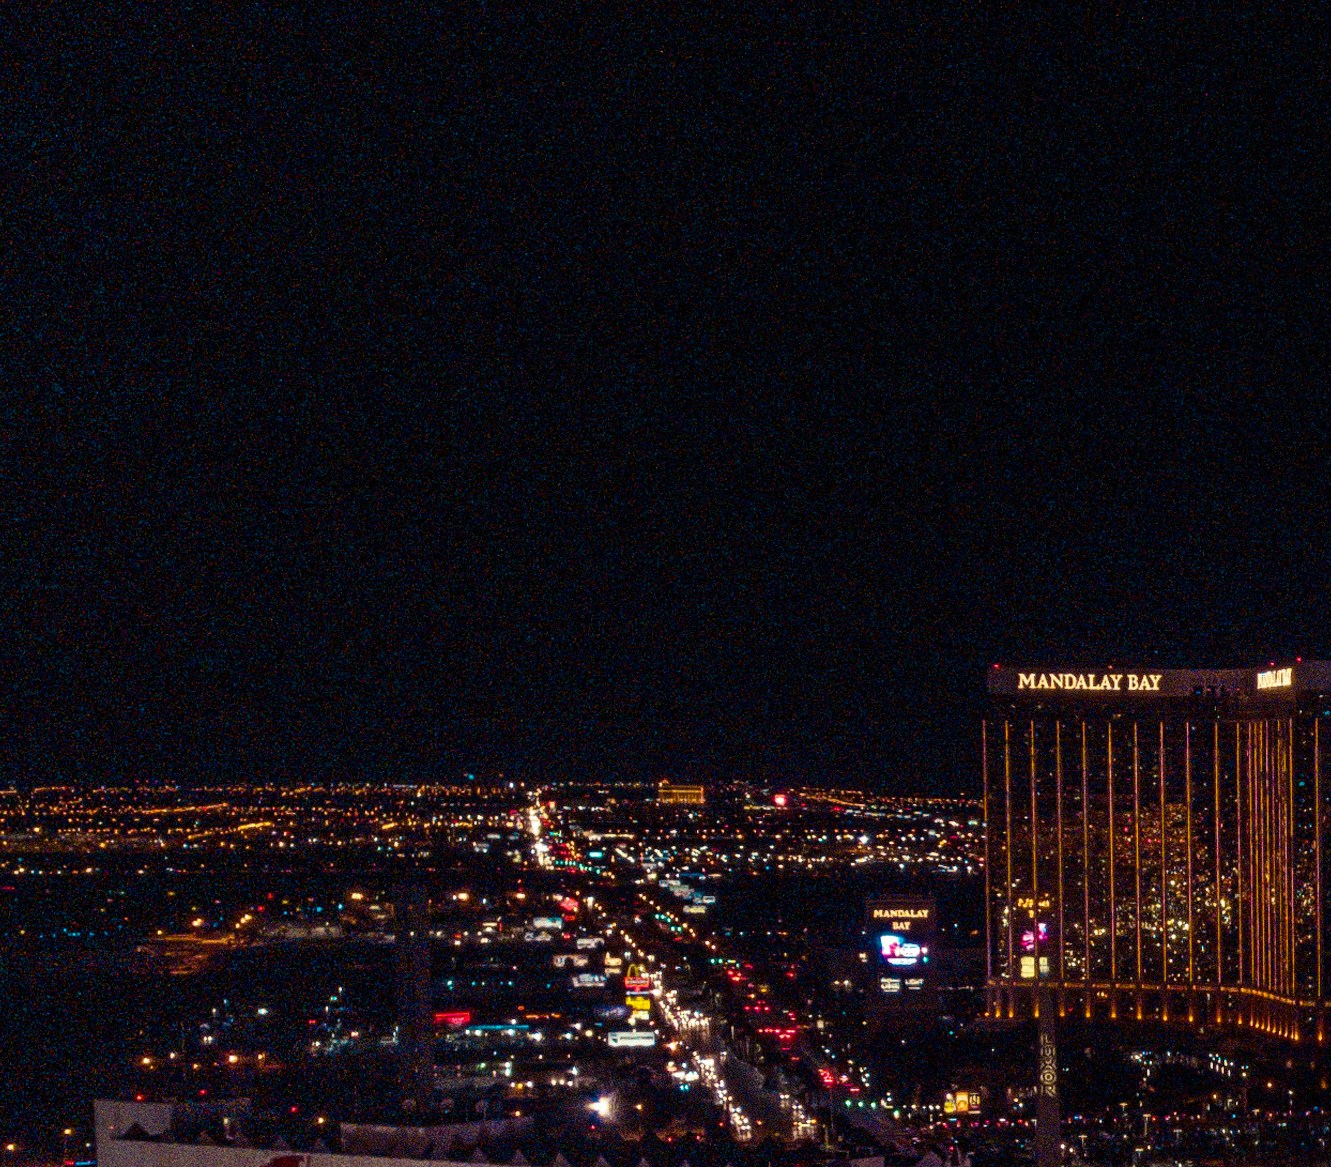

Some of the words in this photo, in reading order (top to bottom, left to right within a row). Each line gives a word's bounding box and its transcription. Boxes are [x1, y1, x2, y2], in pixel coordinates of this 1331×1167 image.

[1018, 673, 1123, 691] MANDALAY
[1128, 674, 1162, 691] BAY
[873, 909, 929, 919] MANDALAY
[892, 921, 911, 931] BAY
[1040, 1033, 1057, 1096] LUXOR
